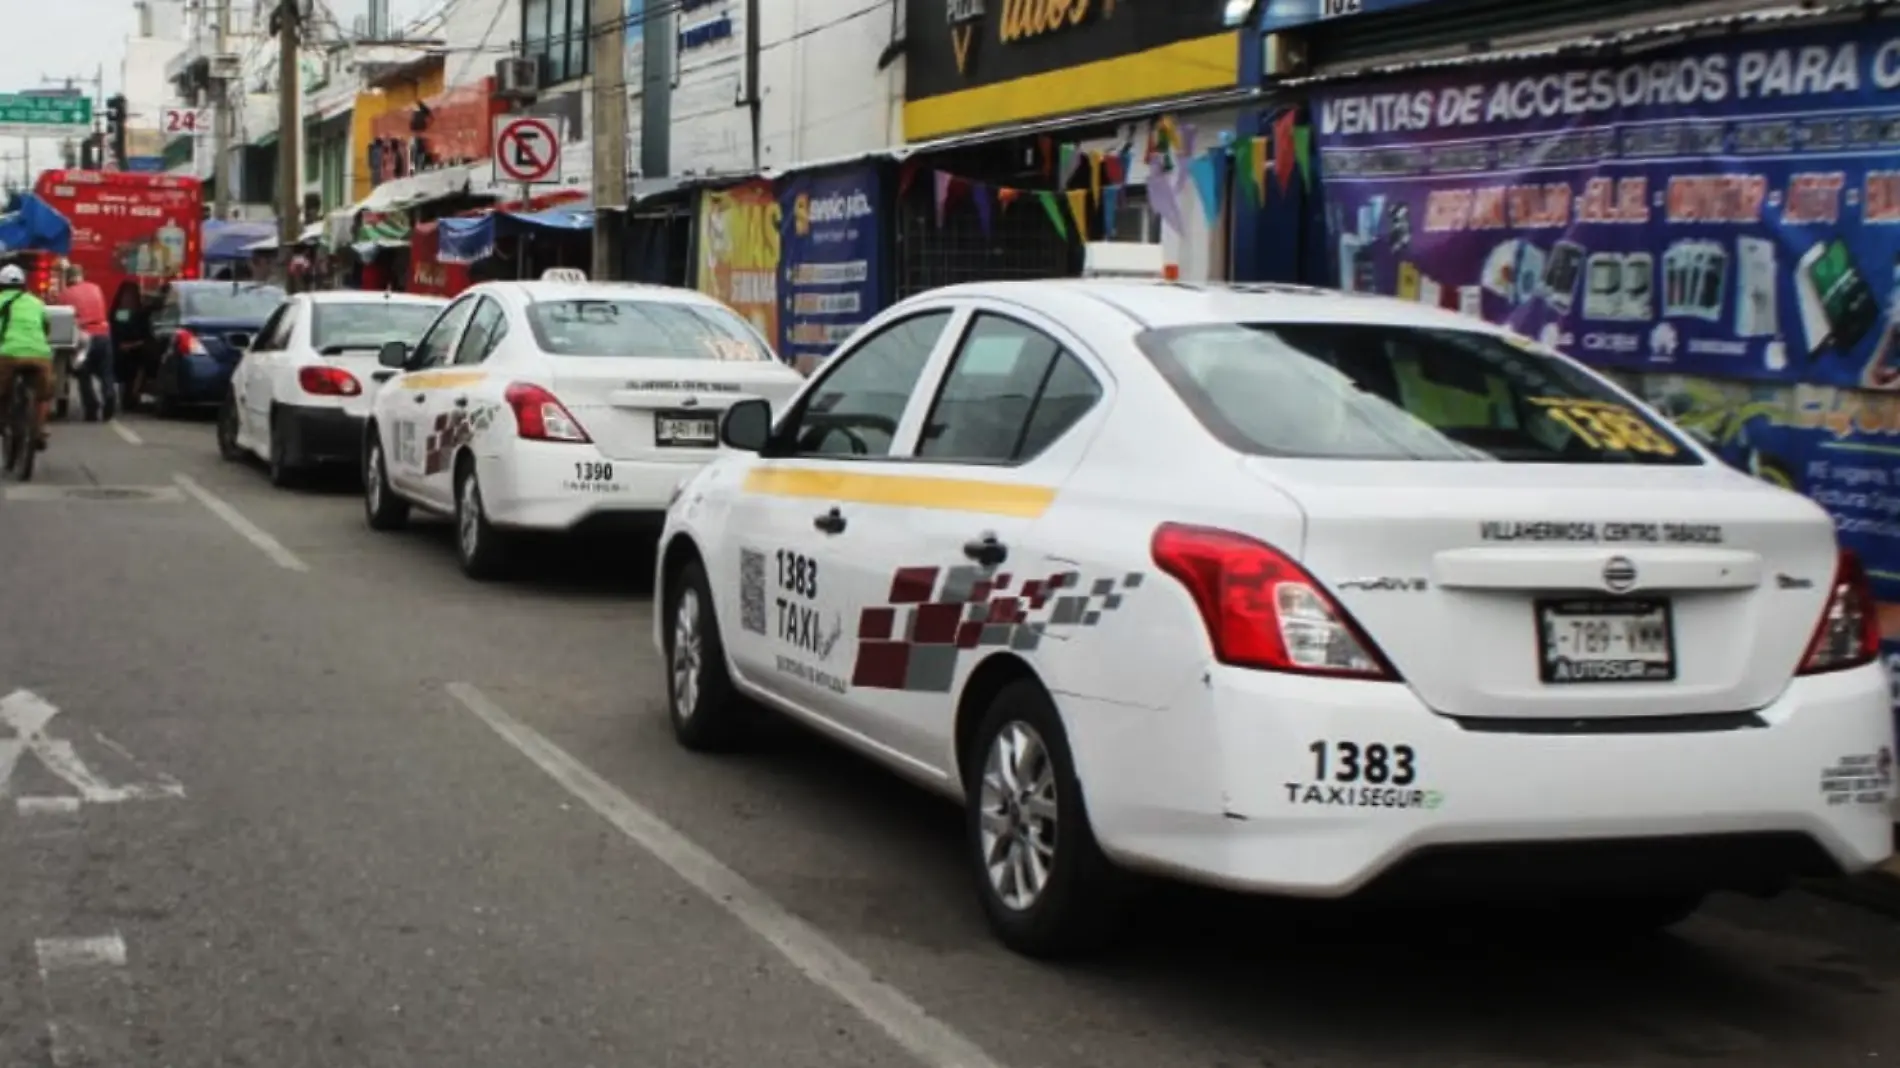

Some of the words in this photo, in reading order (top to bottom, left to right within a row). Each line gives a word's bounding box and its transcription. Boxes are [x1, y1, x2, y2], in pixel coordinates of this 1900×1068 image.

[1322, 90, 1431, 134] VENTAS
[1436, 85, 1485, 127] DE
[1487, 54, 1728, 121] ACCESORIOS
[1737, 41, 1860, 99] PARA
[574, 462, 613, 481] 1390
[776, 548, 818, 599] 1383
[776, 598, 819, 654] TAXI
[1554, 658, 1647, 680] AUTOSUR
[1309, 740, 1416, 786] 1383
